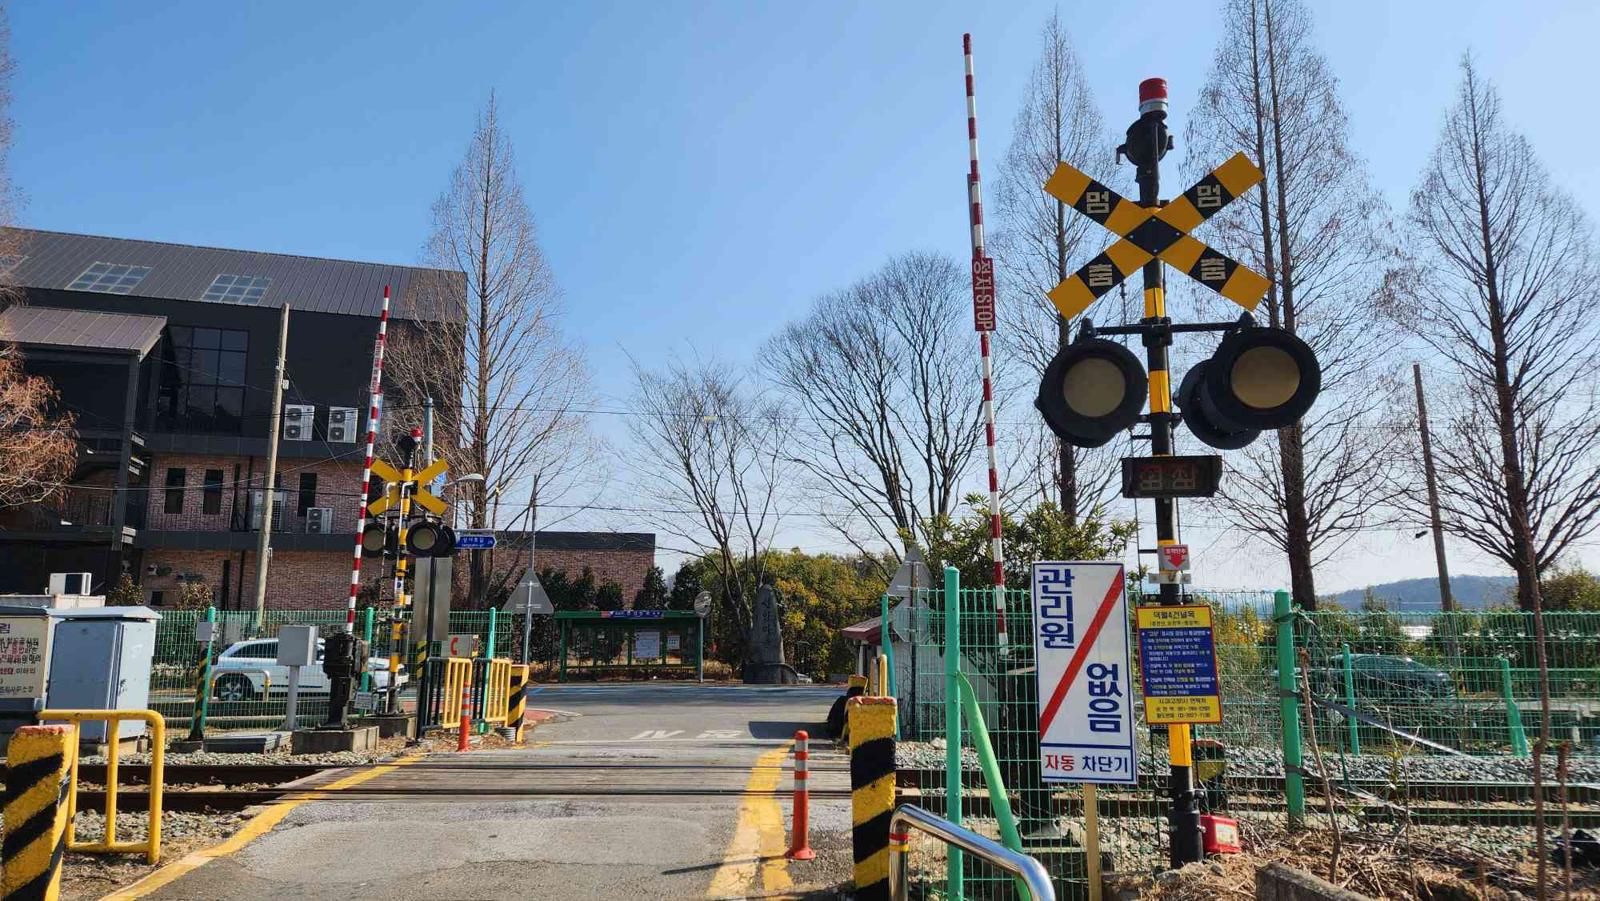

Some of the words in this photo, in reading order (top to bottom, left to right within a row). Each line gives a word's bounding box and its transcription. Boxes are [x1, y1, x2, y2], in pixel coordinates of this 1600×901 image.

[1086, 191, 1110, 214] 멈
[1197, 184, 1222, 208] 멈
[1088, 263, 1113, 287] 춤
[1200, 257, 1226, 281] 춤
[976, 294, 994, 330] STOP
[1038, 568, 1075, 649] 관리원
[1086, 663, 1123, 733] 없음
[1044, 754, 1075, 772] 자동
[1082, 755, 1128, 773] 차단기
